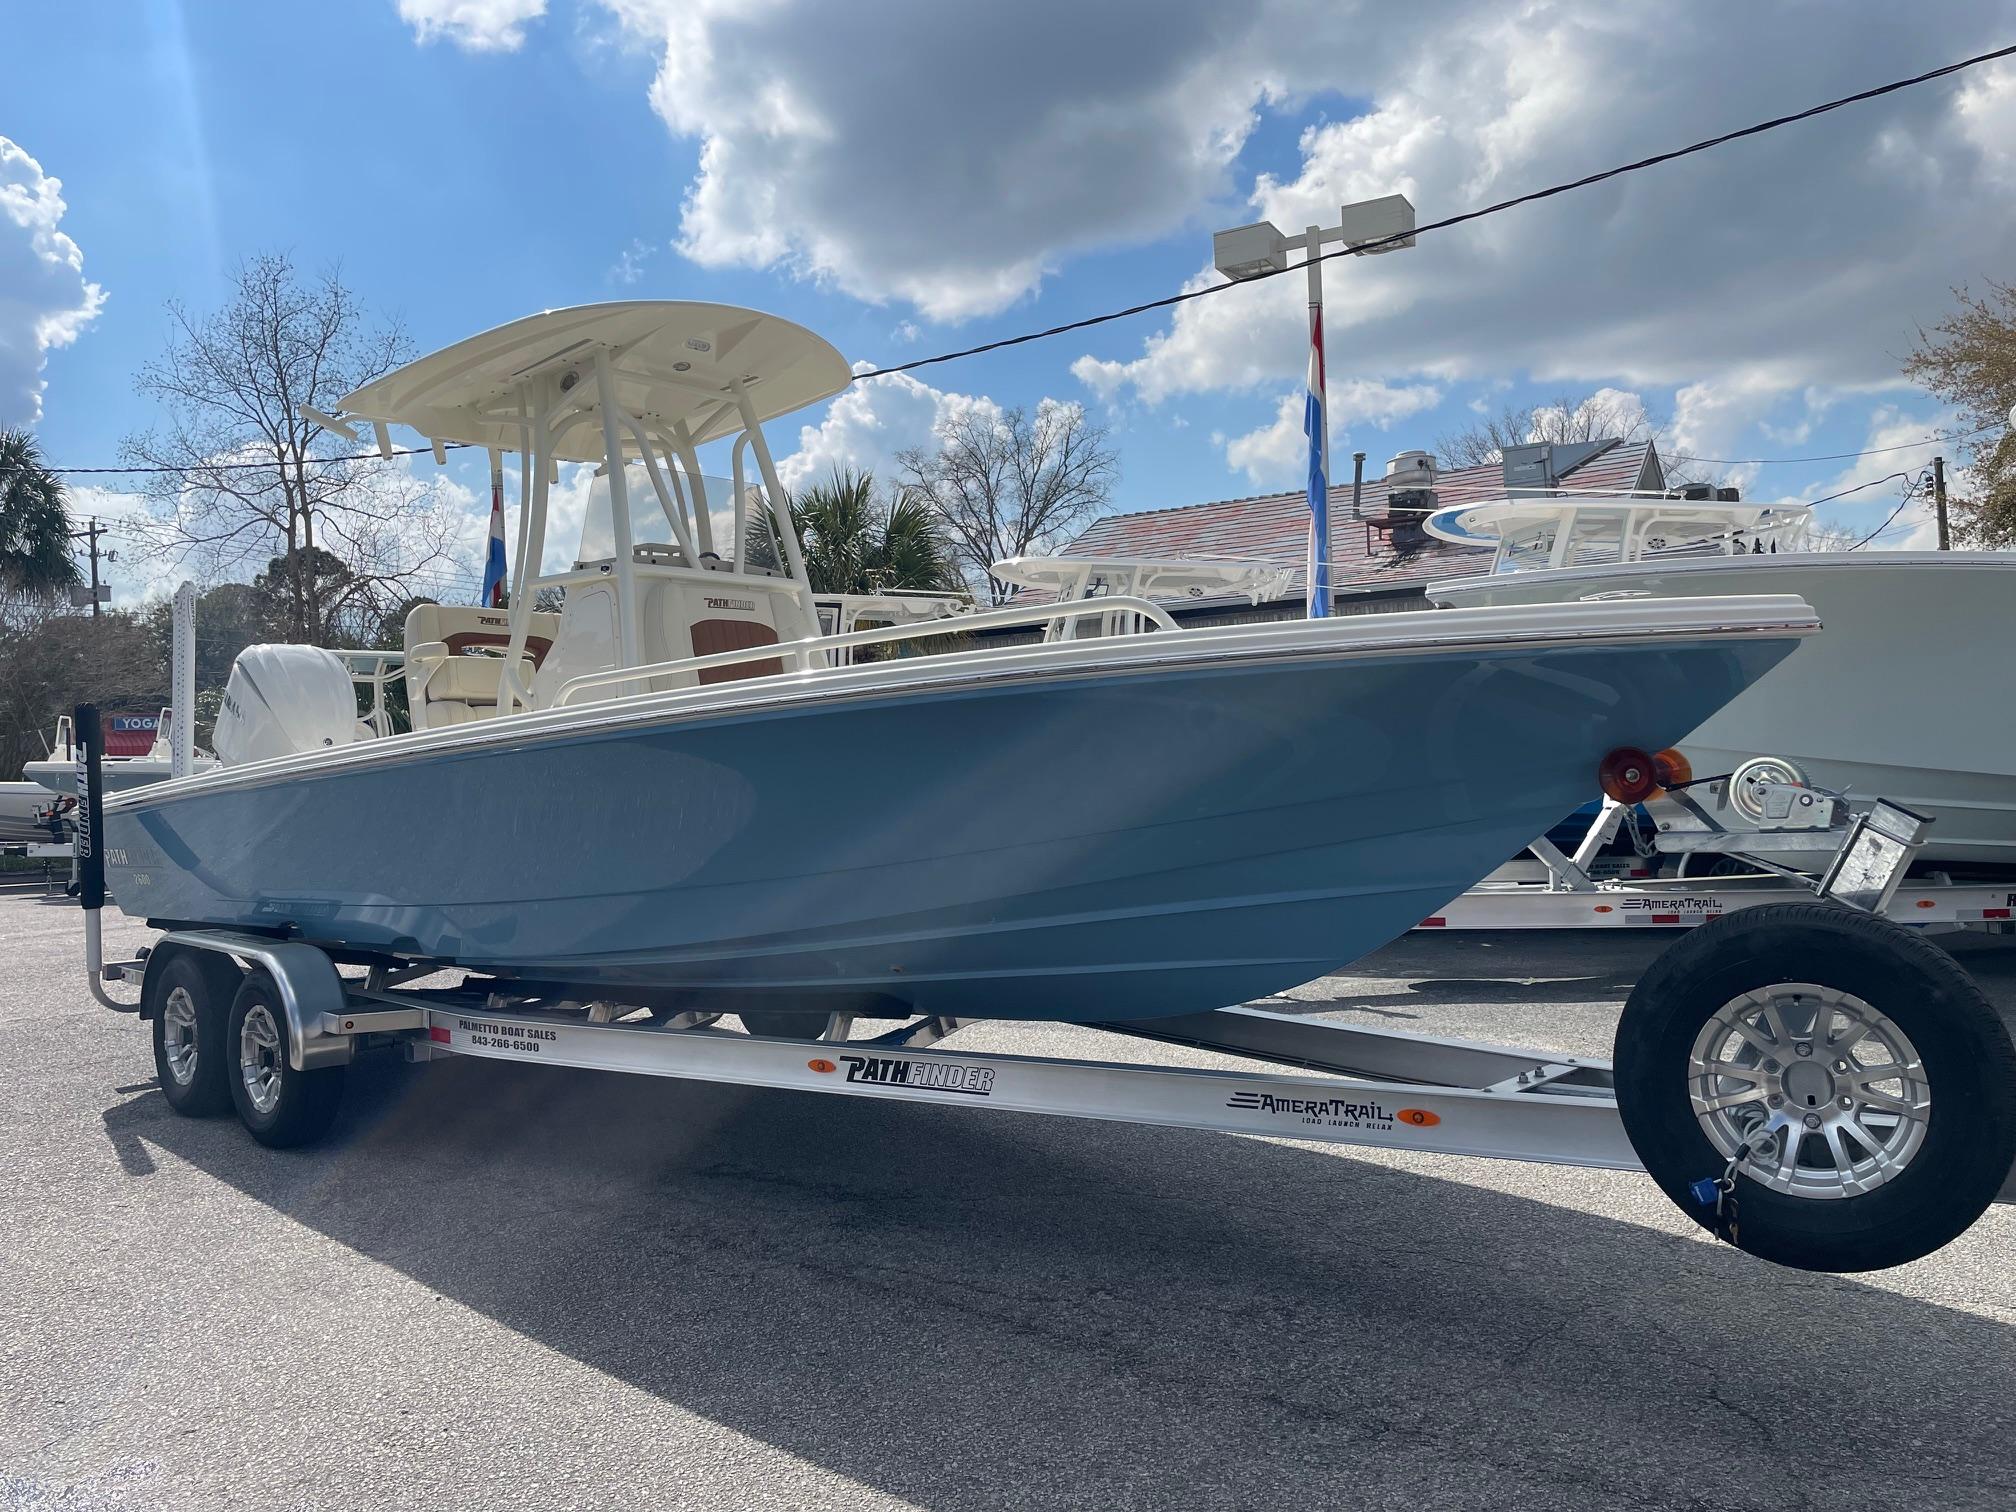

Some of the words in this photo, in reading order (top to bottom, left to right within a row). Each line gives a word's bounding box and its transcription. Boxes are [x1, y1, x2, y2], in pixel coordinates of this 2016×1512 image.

[122, 718, 159, 729] YOGA
[76, 741, 92, 858] PATHFINDER
[459, 1019, 499, 1034] PALMETTO
[501, 1026, 526, 1038] BOAT
[527, 1028, 557, 1041] SALES
[471, 1035, 540, 1052] 843-266-6500
[839, 1055, 996, 1096] PATHFINDER
[1260, 1093, 1394, 1122] AMERATRAIL
[1301, 1117, 1323, 1125] LOAD
[1328, 1118, 1360, 1128] LAUNCH
[1366, 1122, 1393, 1131] RELAX
